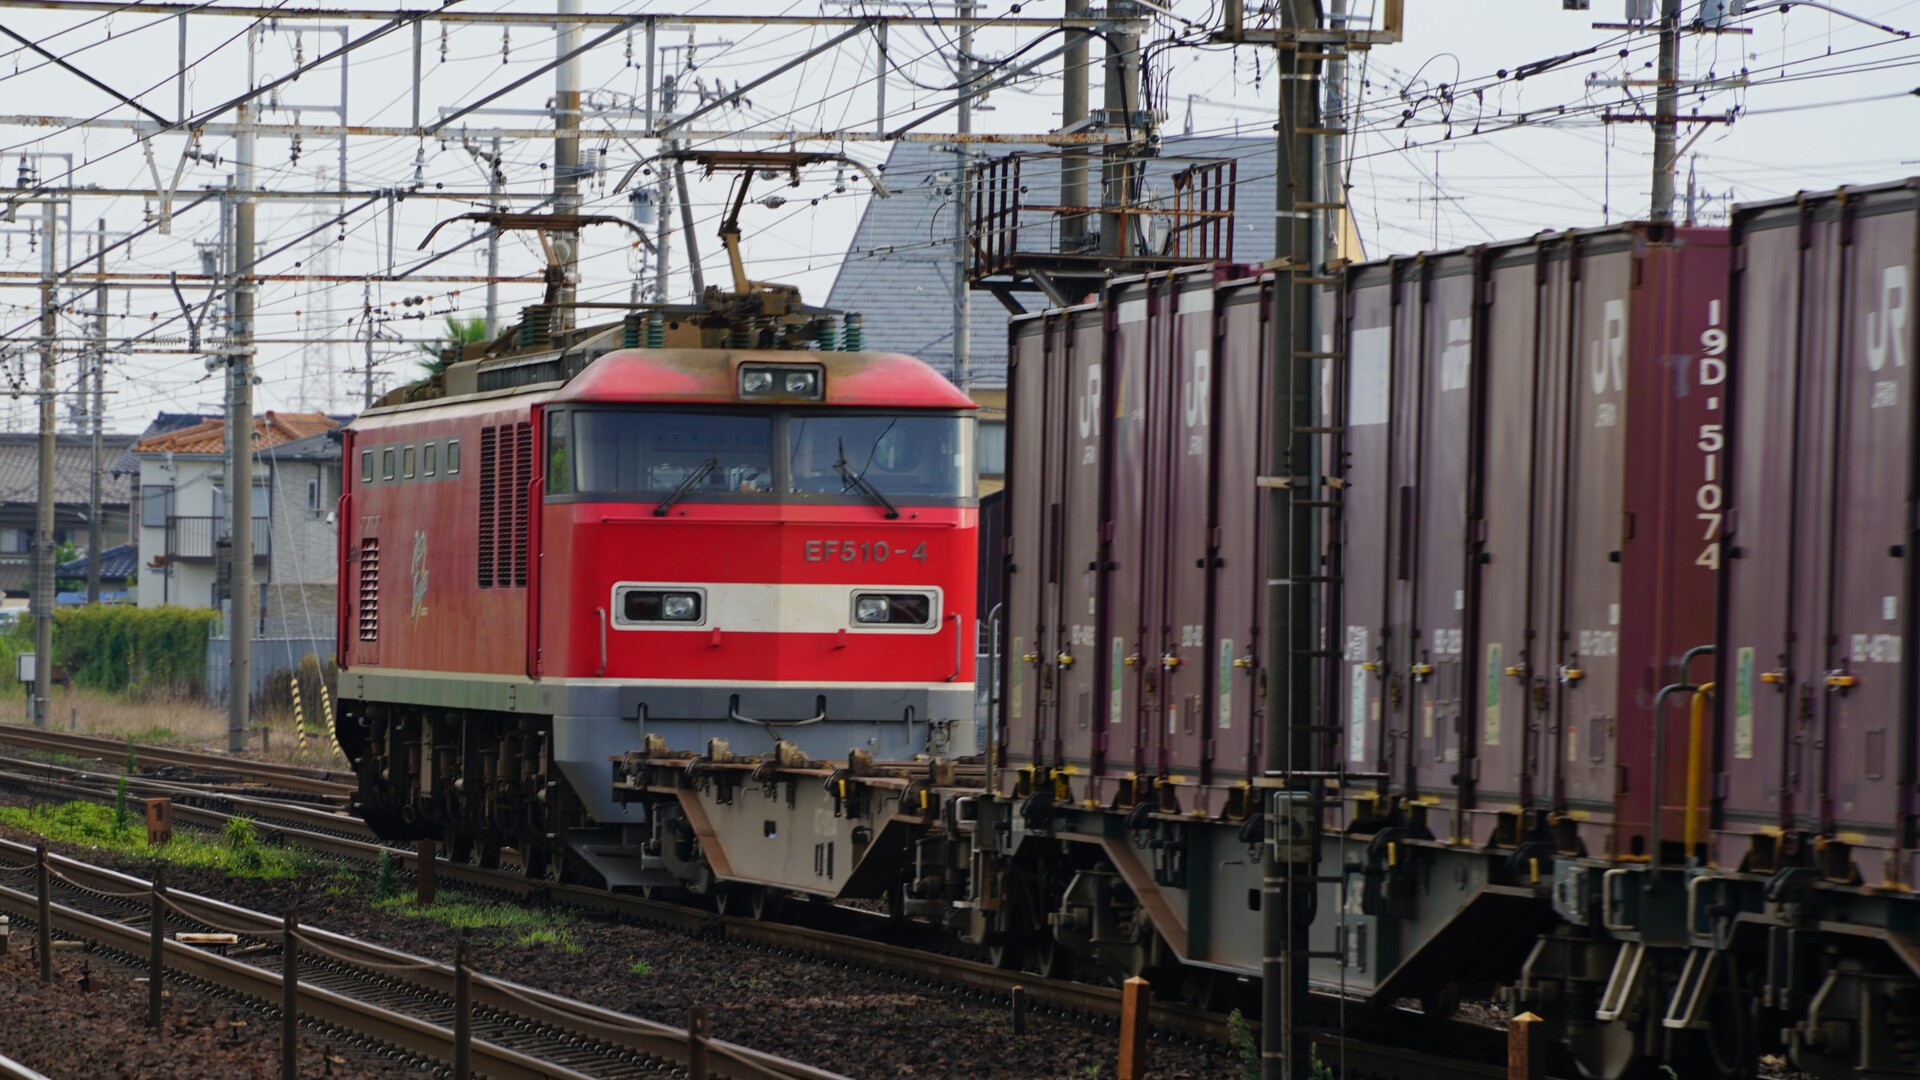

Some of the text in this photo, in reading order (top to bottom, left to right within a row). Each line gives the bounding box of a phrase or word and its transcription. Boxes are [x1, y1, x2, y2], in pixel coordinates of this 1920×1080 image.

[1591, 299, 1625, 394] JR
[1867, 264, 1908, 372] JR
[1080, 363, 1102, 439] JR
[1185, 349, 1209, 428] JR
[805, 540, 928, 562] EF510-4
[152, 803, 162, 821] 1
